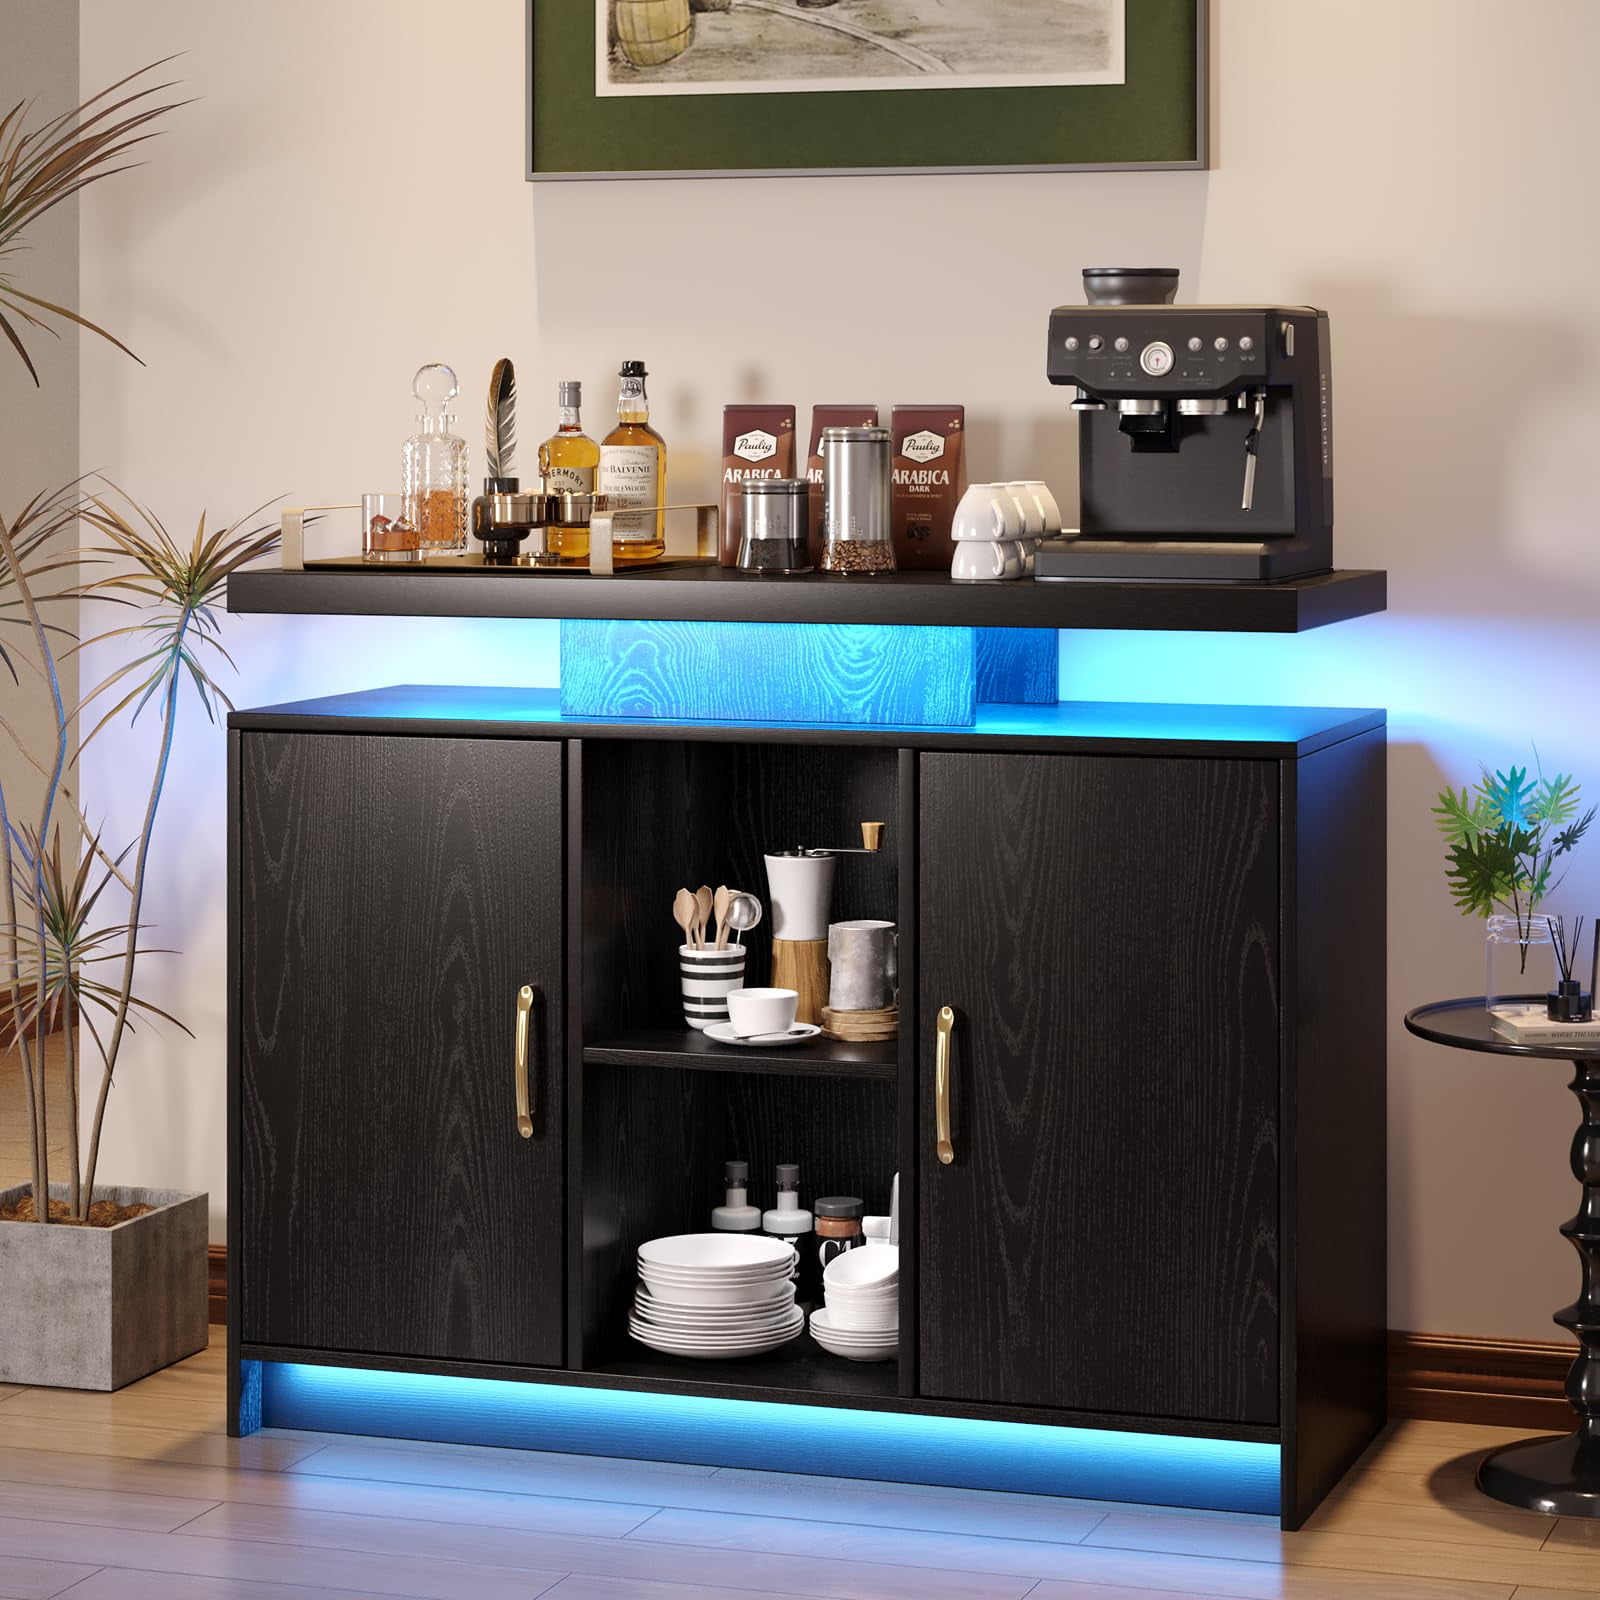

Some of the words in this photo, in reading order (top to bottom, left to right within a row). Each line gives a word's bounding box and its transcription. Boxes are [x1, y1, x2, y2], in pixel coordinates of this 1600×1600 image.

[737, 437, 773, 454] Paulig
[905, 438, 940, 454] Paulig
[610, 464, 653, 473] BALVENIE
[723, 467, 782, 483] ARABICA
[891, 468, 950, 485] ARABICA
[909, 485, 931, 493] DARK
[616, 498, 628, 508] 12
